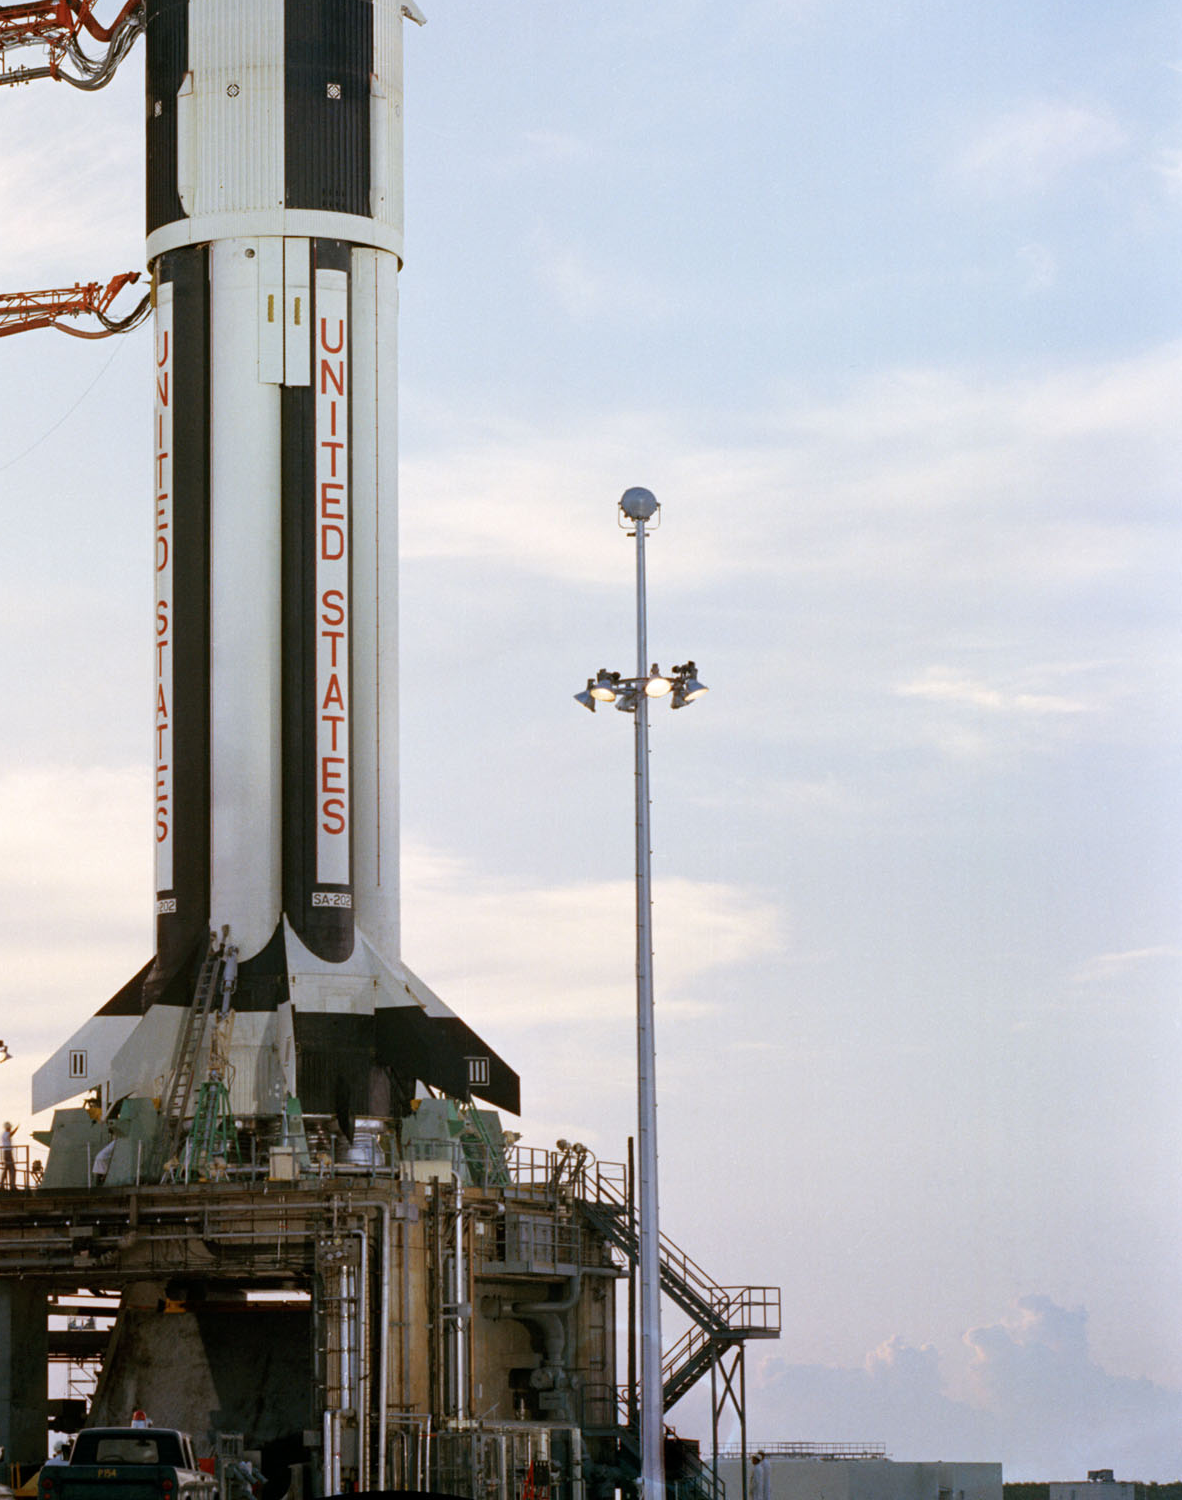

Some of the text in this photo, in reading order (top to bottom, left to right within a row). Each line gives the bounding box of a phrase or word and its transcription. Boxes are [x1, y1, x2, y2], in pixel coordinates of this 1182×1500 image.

[321, 317, 345, 835] UNITED STATES
[156, 600, 169, 843] STATES
[313, 893, 351, 907] SA-202
